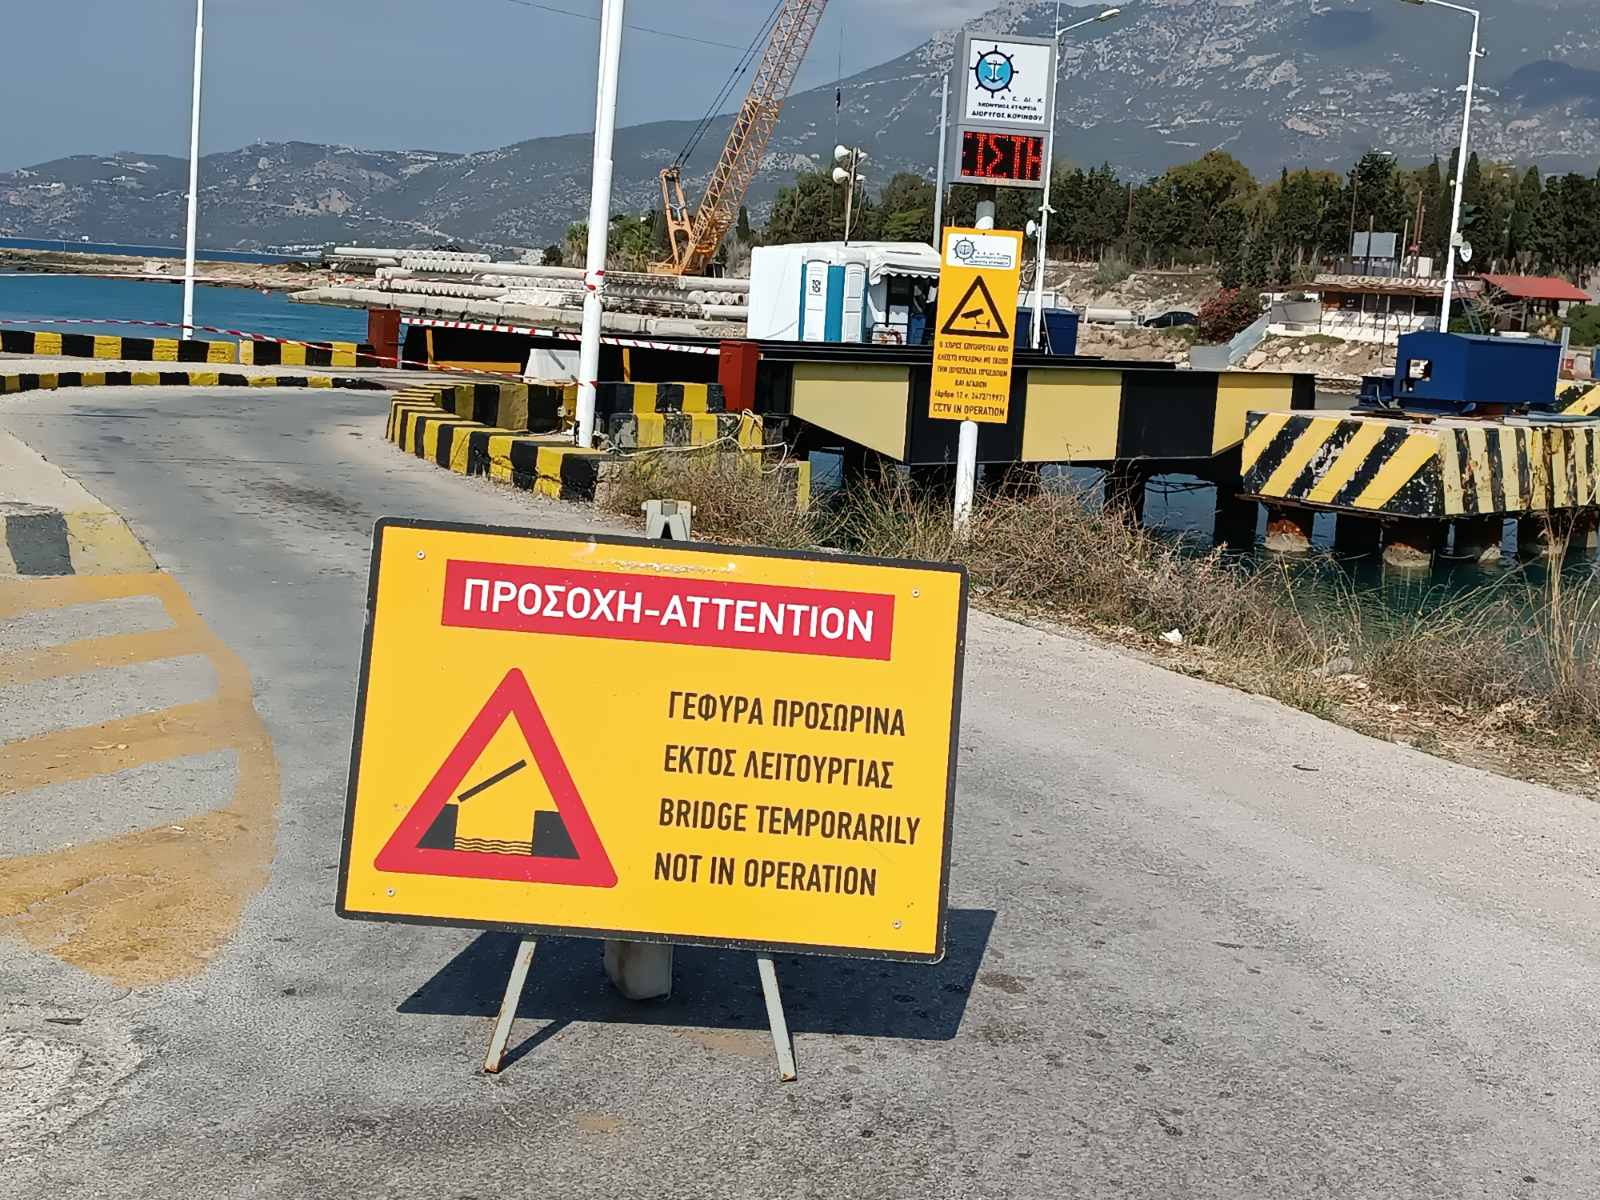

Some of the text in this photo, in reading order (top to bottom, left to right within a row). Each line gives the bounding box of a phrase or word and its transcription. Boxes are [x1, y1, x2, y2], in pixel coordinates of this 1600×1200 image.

[933, 403, 1005, 416] CCTV IN OPERATION
[668, 691, 905, 736] ΓΕΦΥΡΑ ΠΡΟΣΩΡΙΝΑ
[664, 744, 894, 789] ΕΚΤΟΣ ΛΕΙΤΟΥΡΓΙΑΣ
[659, 798, 921, 845] BRIDGE TEMPORARILY
[654, 852, 877, 896] NOT IN OPERATION
